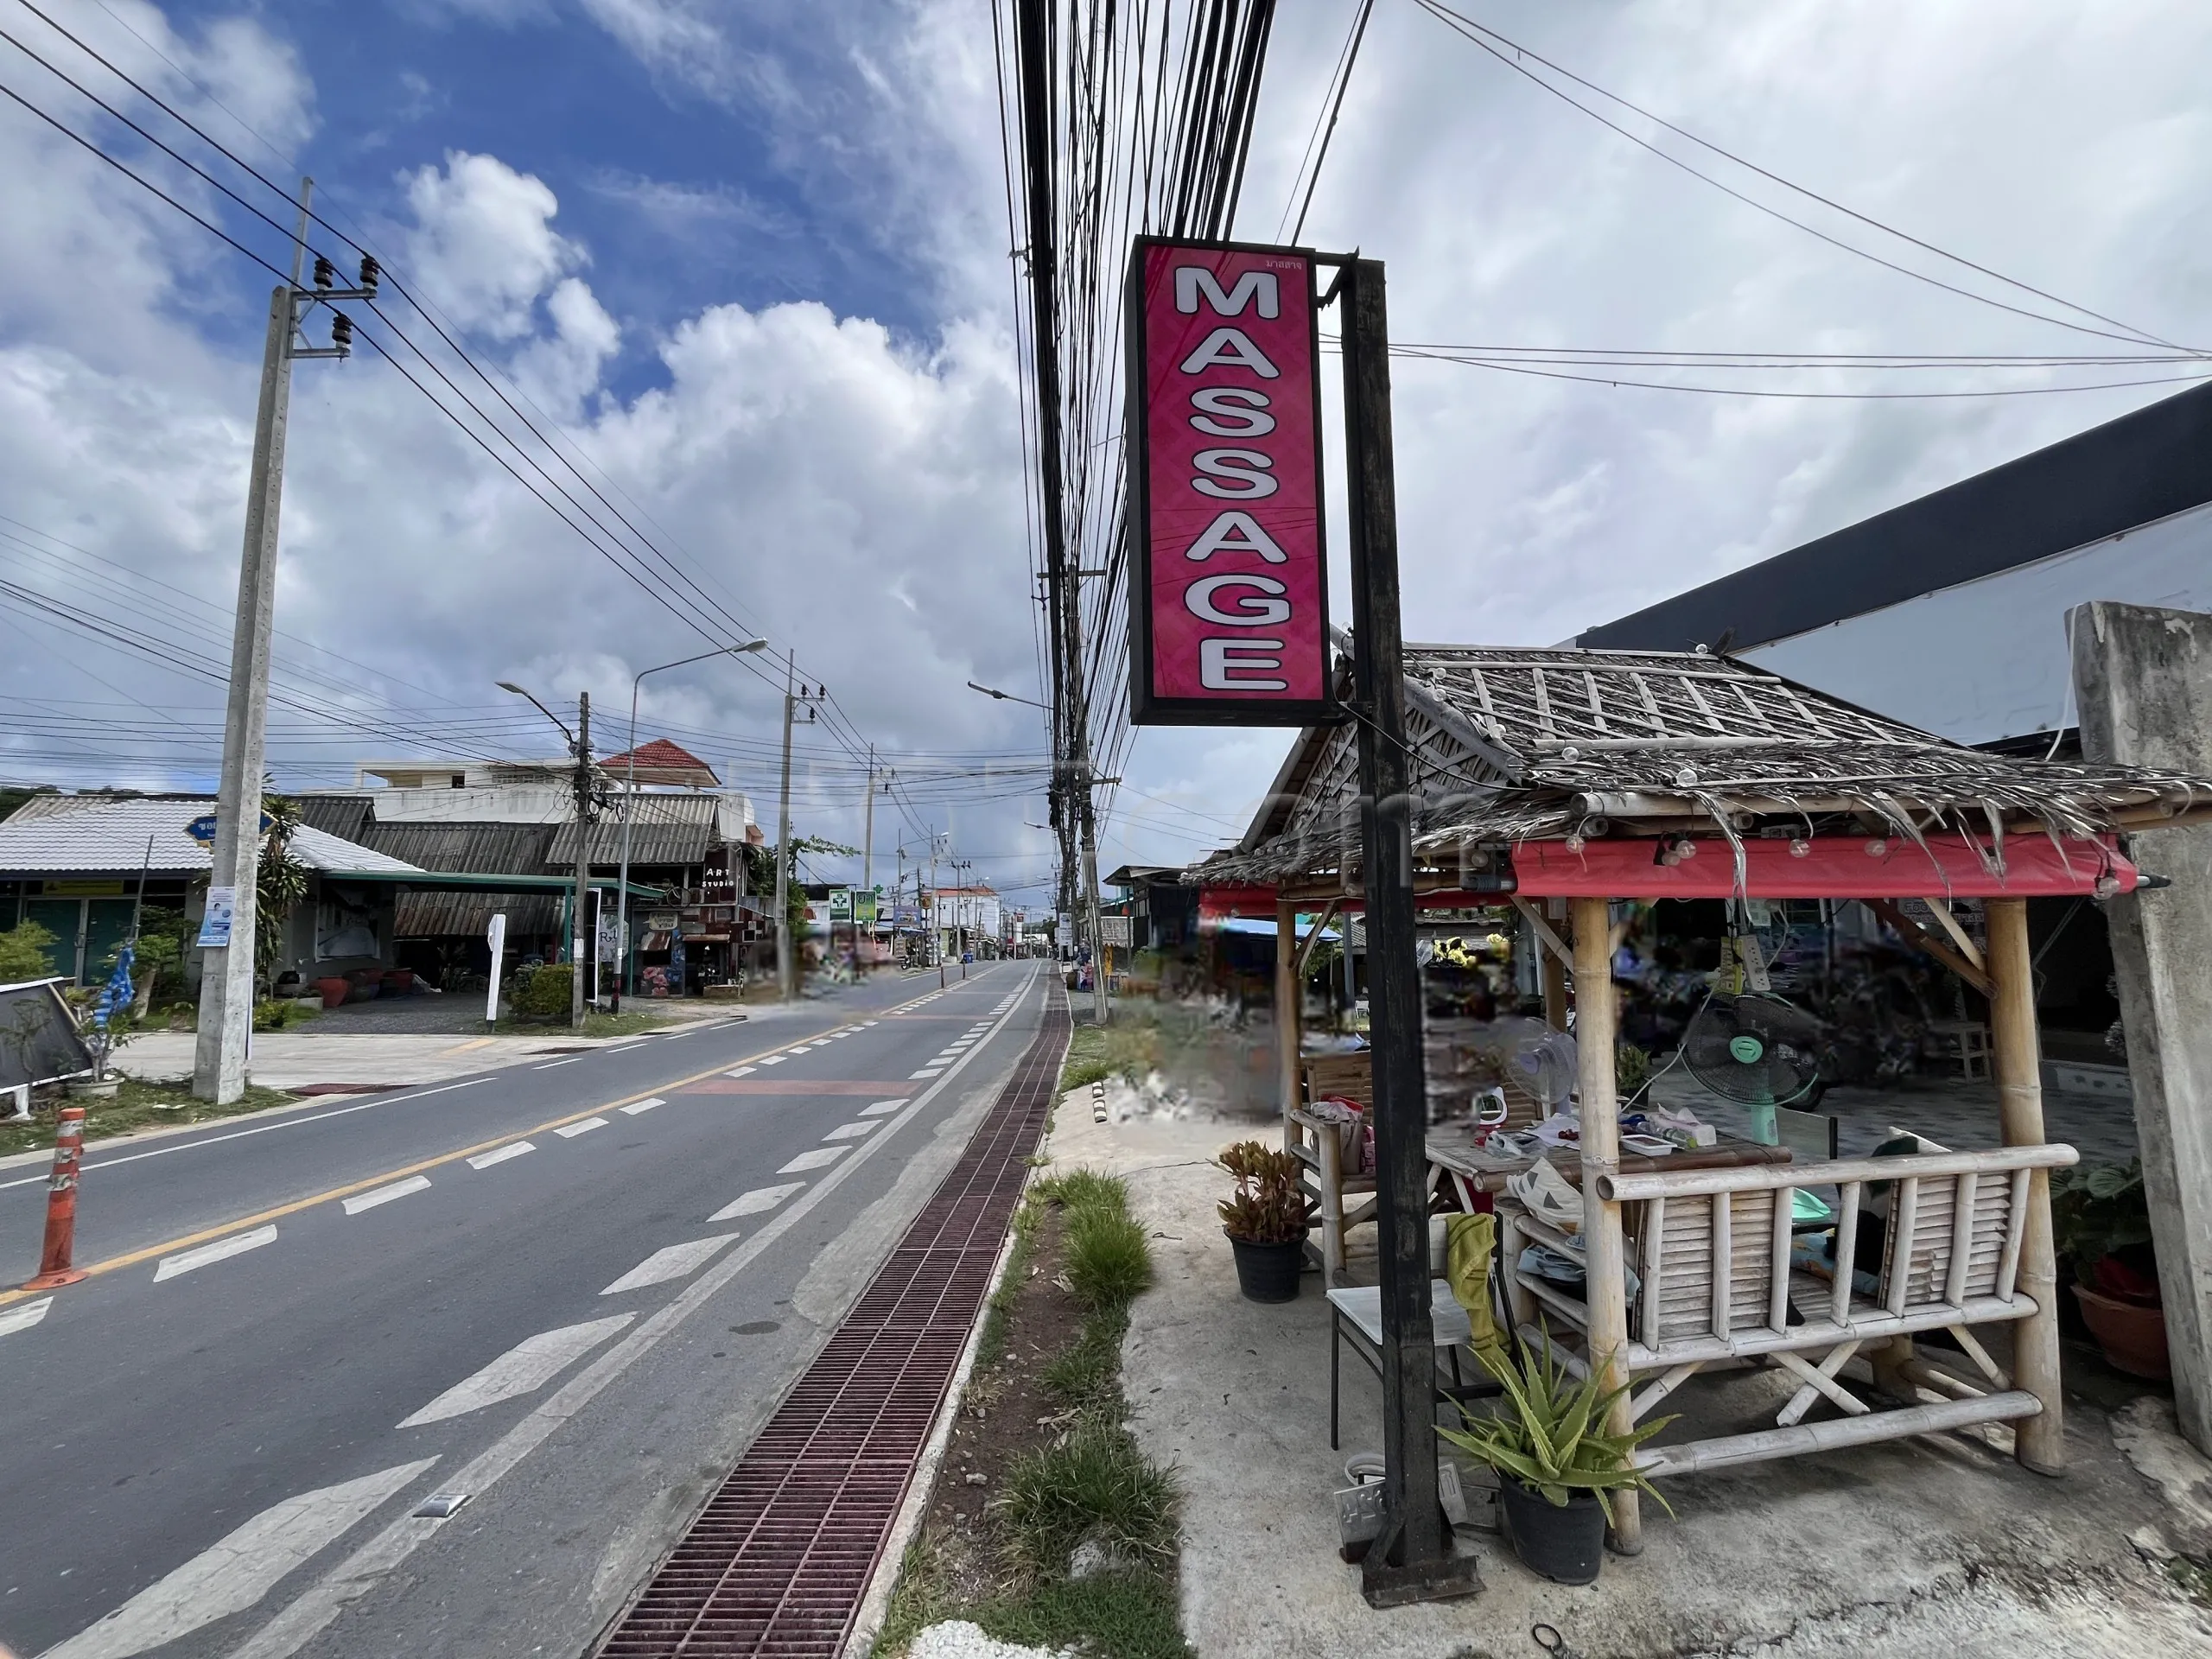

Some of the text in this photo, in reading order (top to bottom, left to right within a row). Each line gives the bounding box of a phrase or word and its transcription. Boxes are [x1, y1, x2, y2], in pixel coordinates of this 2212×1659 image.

[1173, 265, 1292, 691] MASSAGE
[706, 868, 730, 877] ART
[857, 893, 874, 905] ยา
